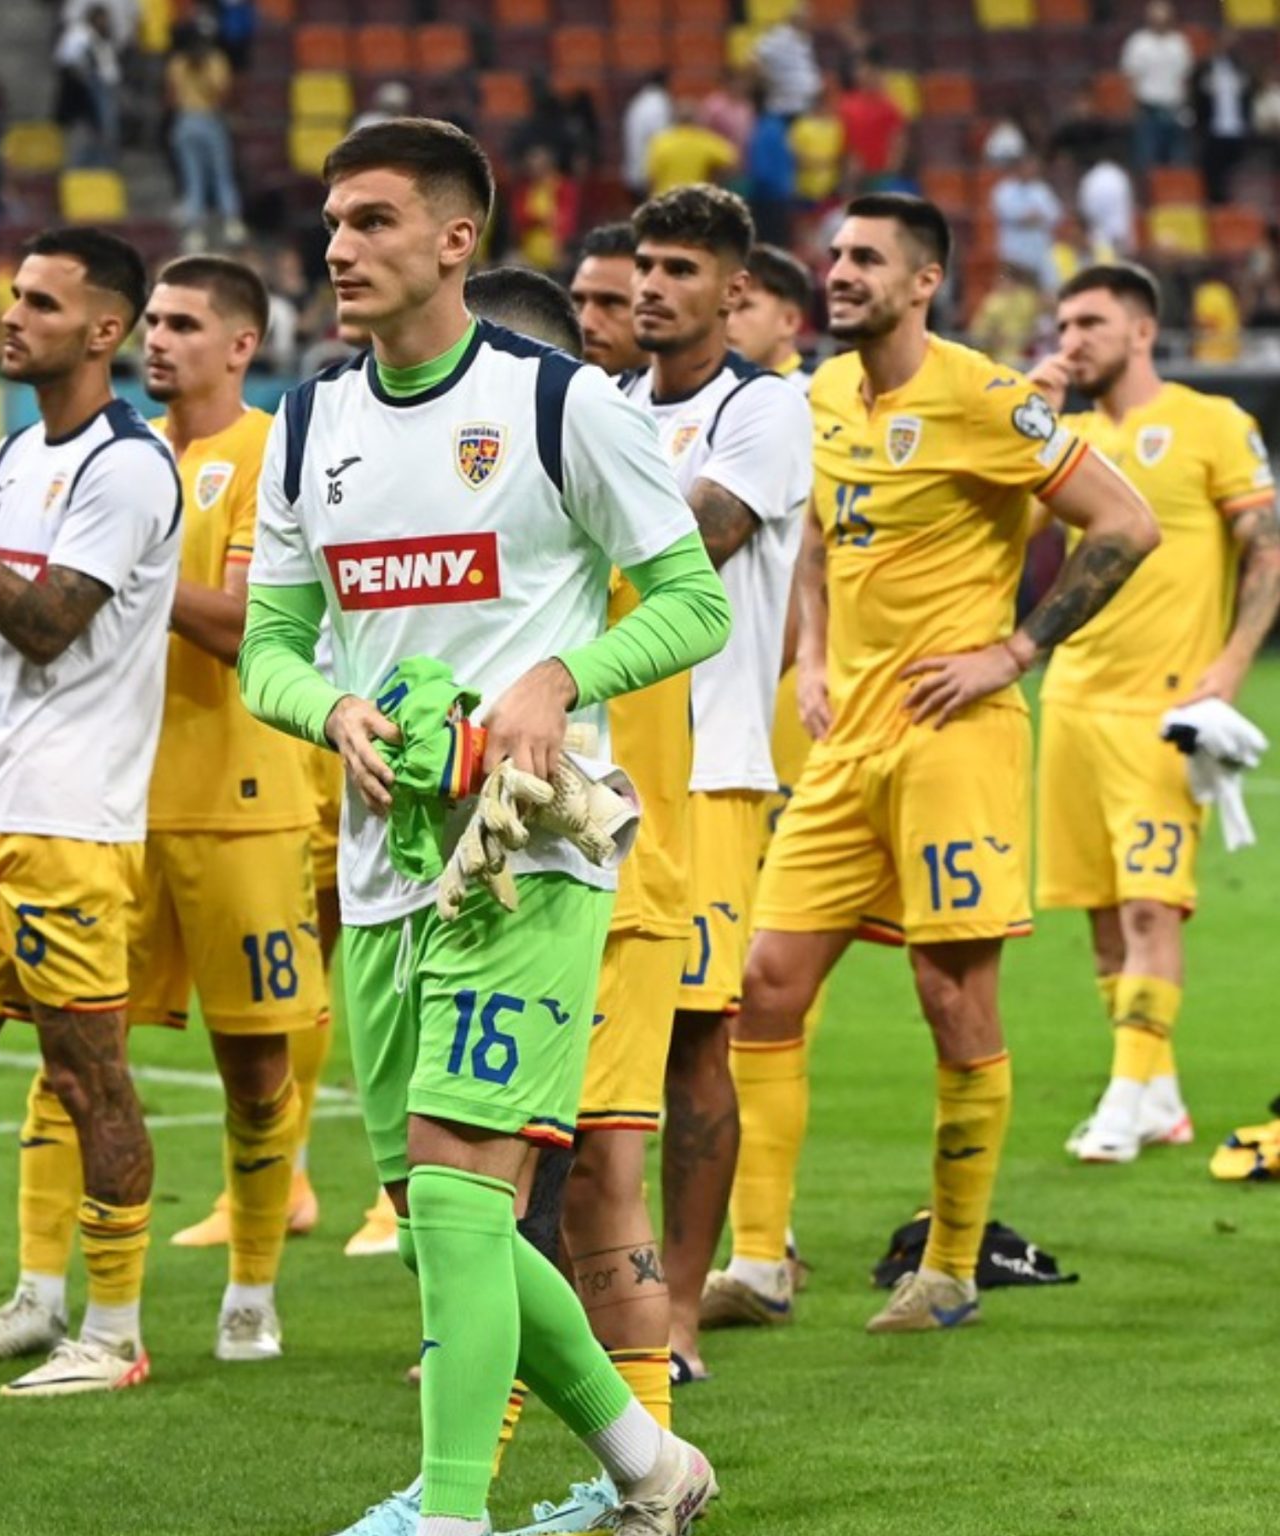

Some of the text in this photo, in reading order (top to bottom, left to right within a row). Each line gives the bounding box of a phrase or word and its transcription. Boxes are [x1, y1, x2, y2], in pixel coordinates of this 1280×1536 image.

[327, 481, 343, 505] 16
[836, 484, 876, 547] 15
[923, 842, 981, 911] 15
[1125, 821, 1183, 876] 23
[16, 903, 46, 968] 6
[243, 931, 298, 1001] 18
[447, 990, 525, 1086] 16
